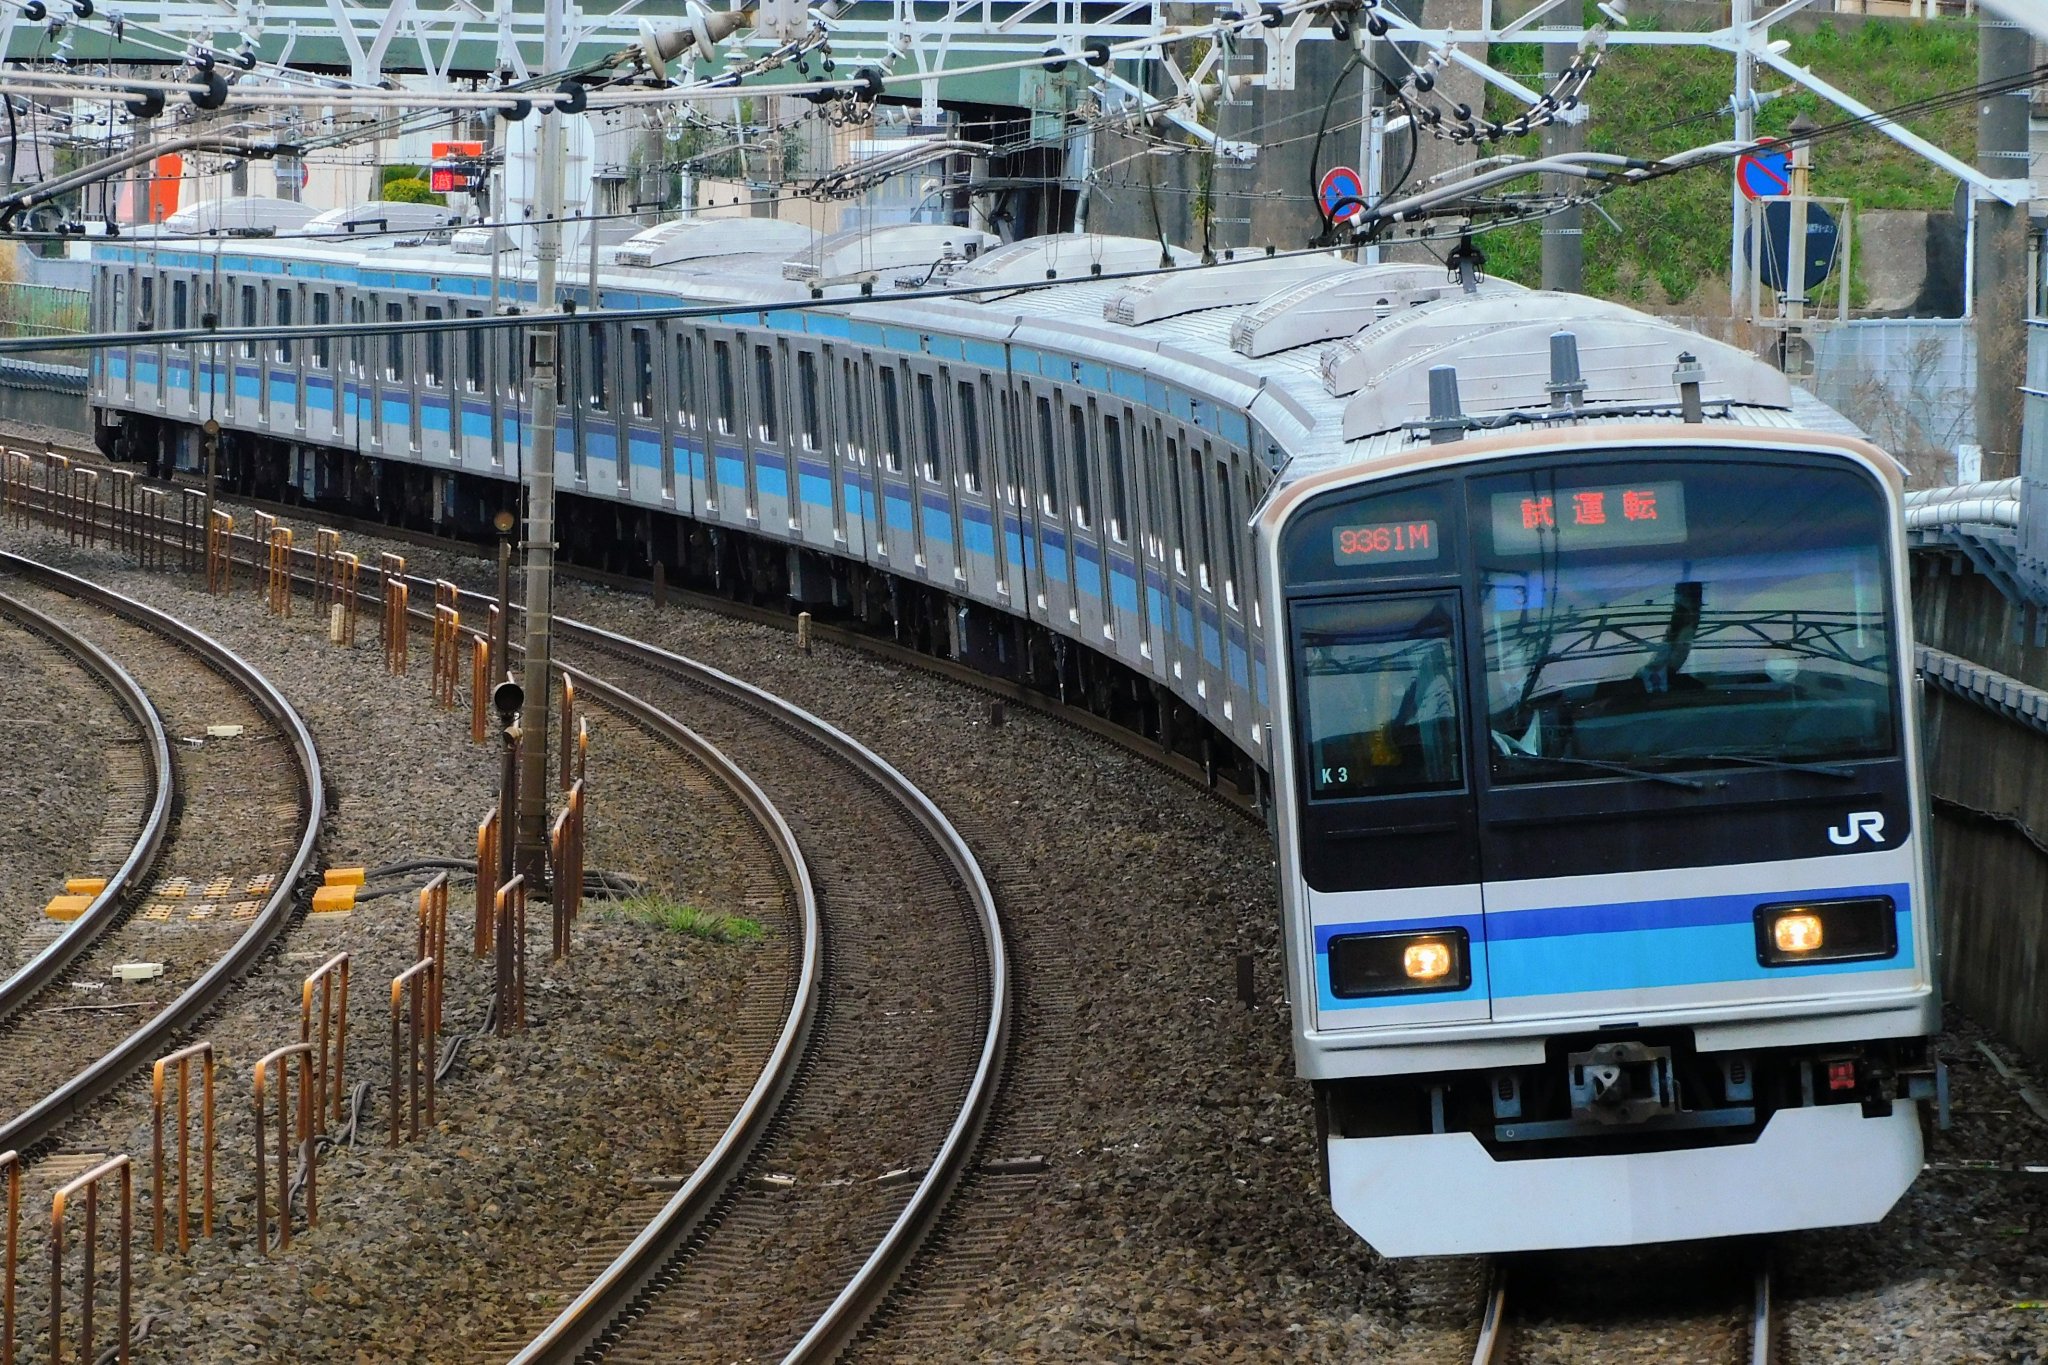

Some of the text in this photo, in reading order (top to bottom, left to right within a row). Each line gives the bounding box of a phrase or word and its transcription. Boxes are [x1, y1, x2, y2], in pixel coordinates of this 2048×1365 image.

[1520, 489, 1657, 529] 試運転
[1340, 523, 1429, 554] 9361M
[1828, 811, 1885, 845] JR
